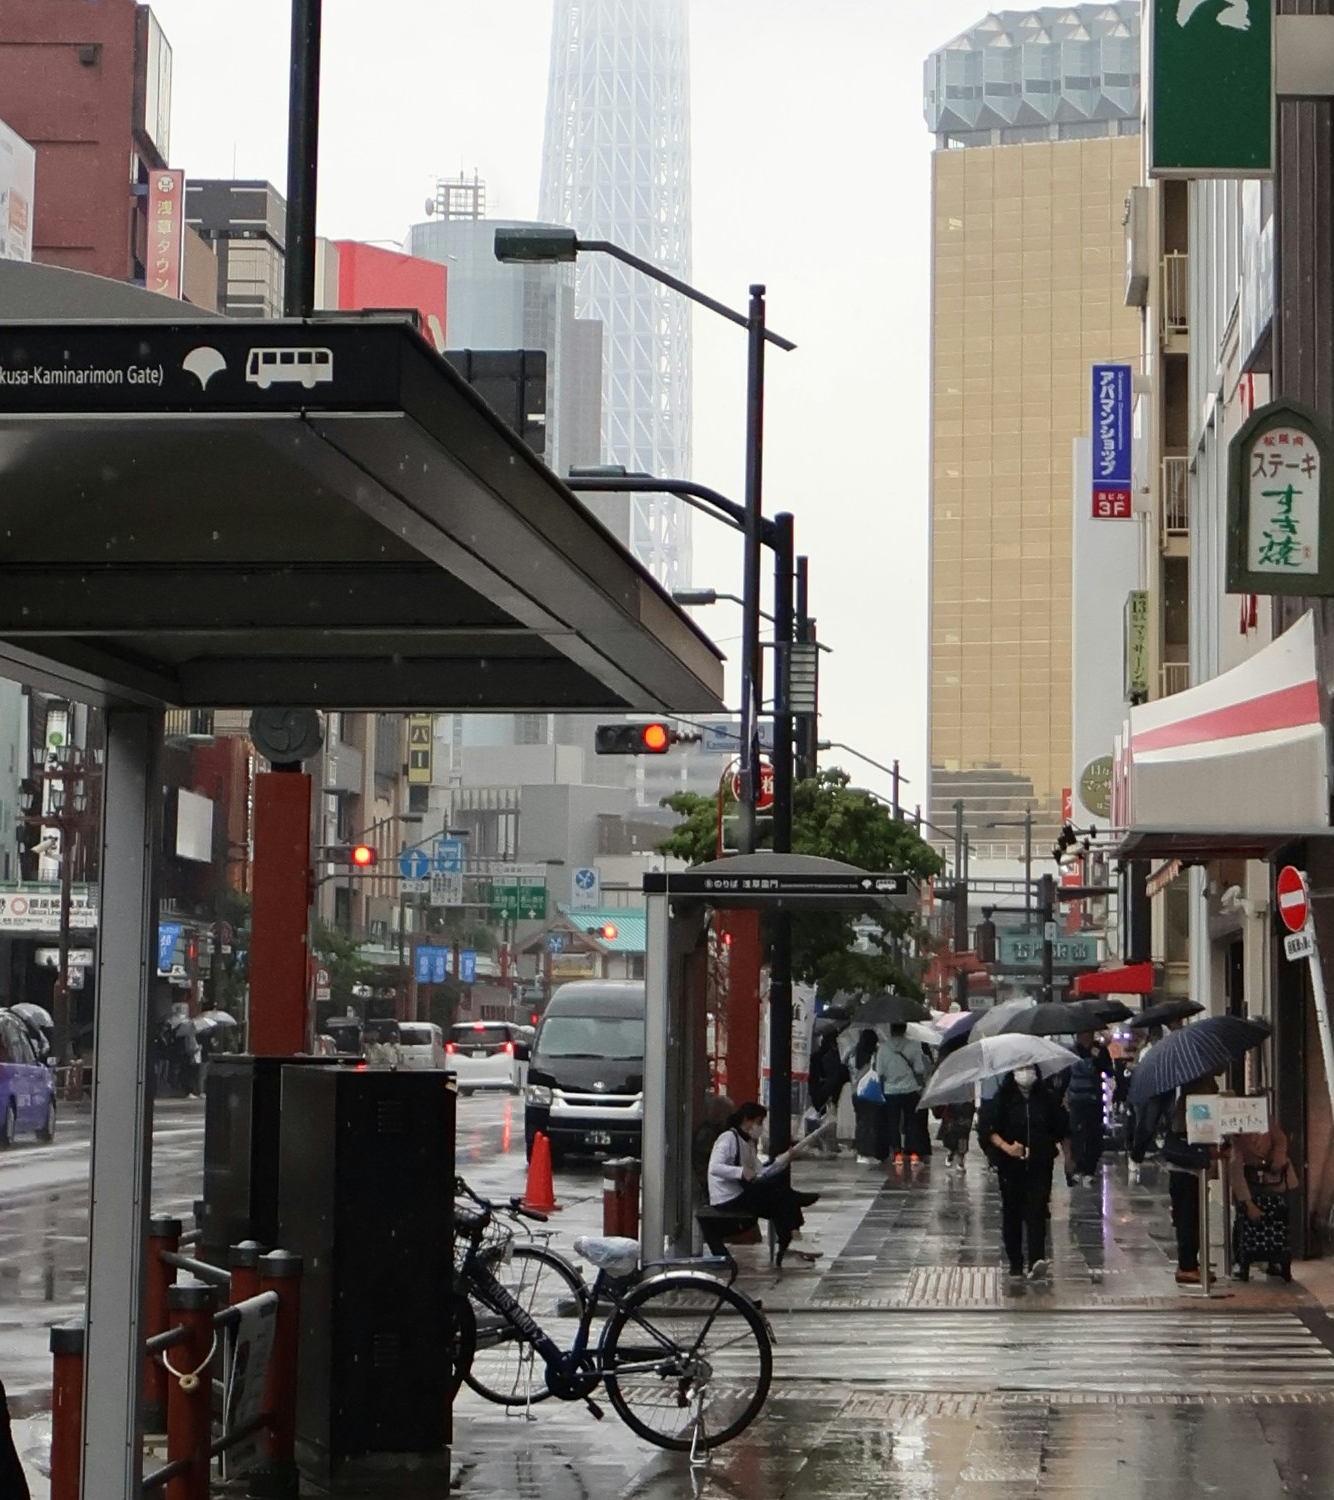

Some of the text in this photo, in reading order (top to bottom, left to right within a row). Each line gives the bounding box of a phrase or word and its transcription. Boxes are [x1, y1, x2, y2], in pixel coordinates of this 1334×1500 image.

[127, 366, 165, 390] Gate)
[1099, 371, 1117, 476] アパマンショップ
[1251, 451, 1317, 479] ステーキ
[1098, 502, 1126, 515] 3F
